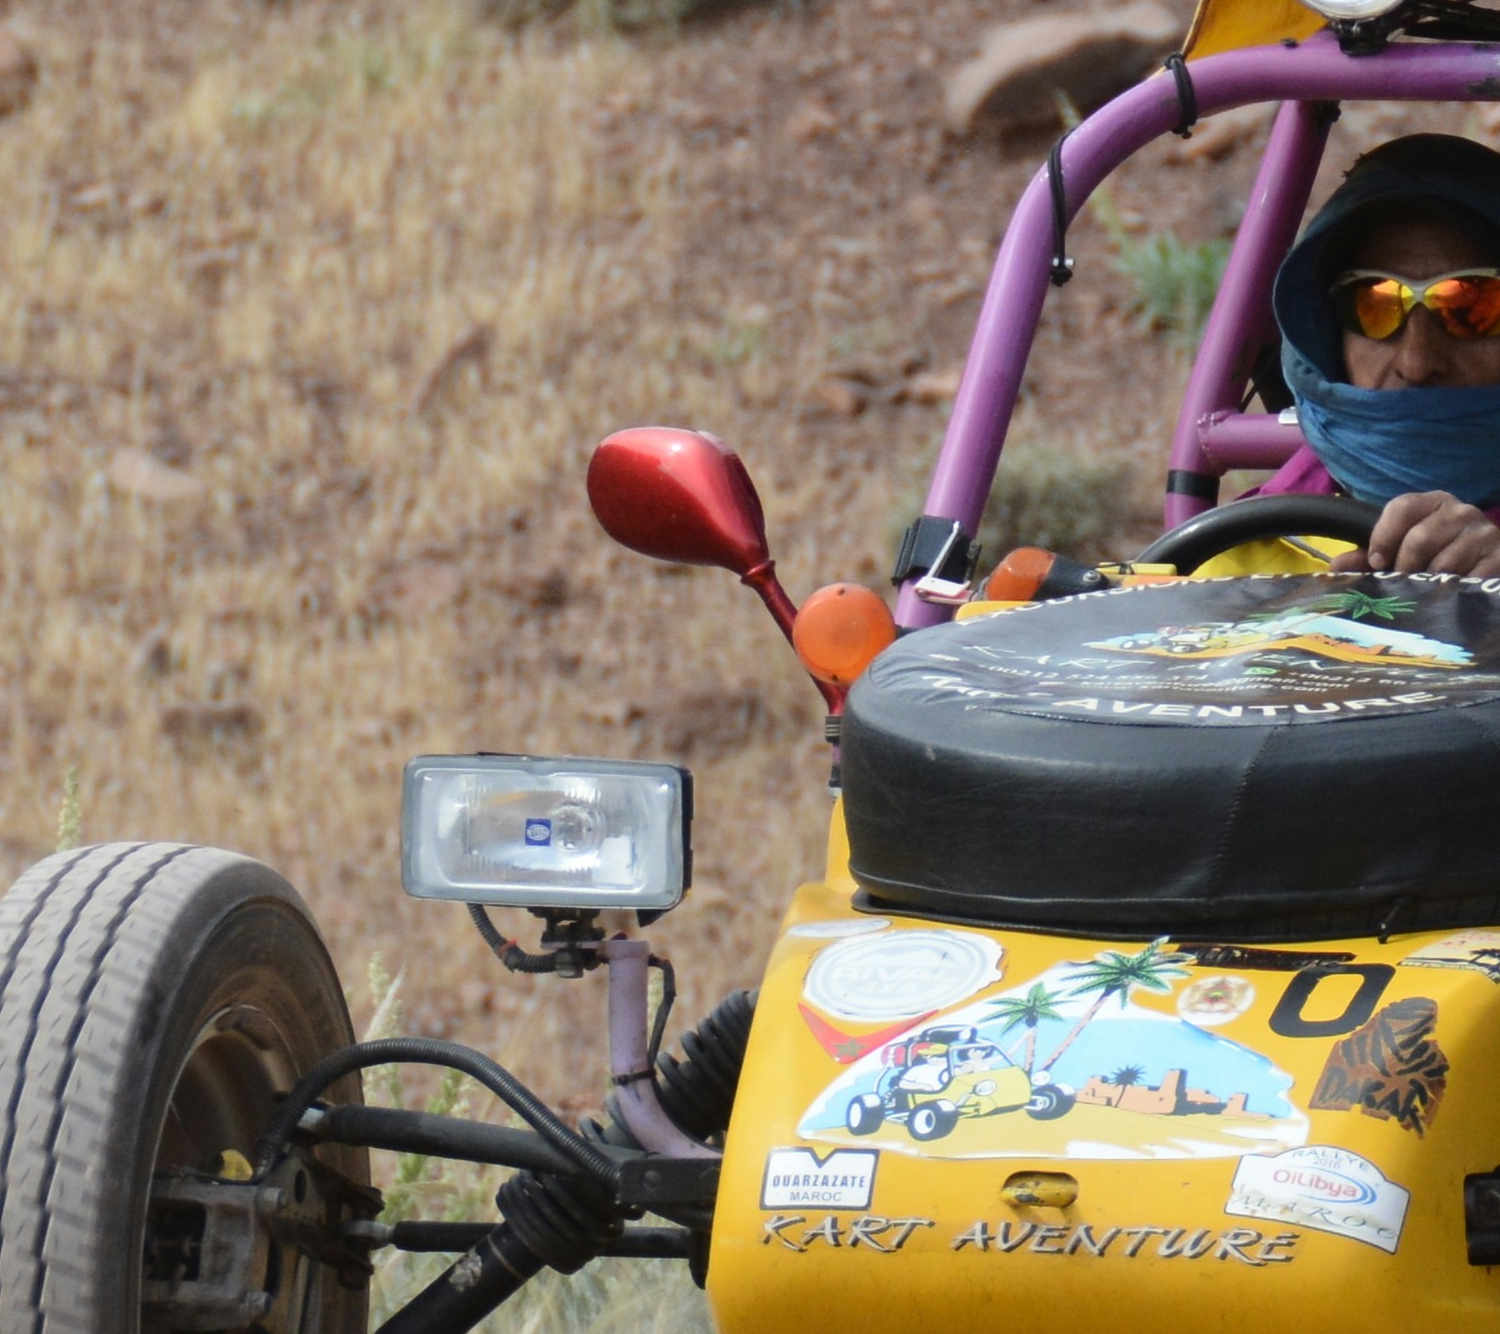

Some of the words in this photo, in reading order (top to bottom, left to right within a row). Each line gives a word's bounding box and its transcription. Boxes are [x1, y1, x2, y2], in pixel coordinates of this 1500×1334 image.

[1052, 691, 1448, 717] AVENTURE
[1317, 1066, 1429, 1139] DAKAR
[1291, 1148, 1370, 1173] RALLYE
[1313, 1157, 1342, 1169] 2016
[772, 1174, 867, 1188] OUARZAZATE
[1273, 1169, 1358, 1199] OiLibya
[789, 1191, 843, 1203] MAROC
[759, 1215, 936, 1253] KART
[950, 1220, 1301, 1267] AVENTURE
